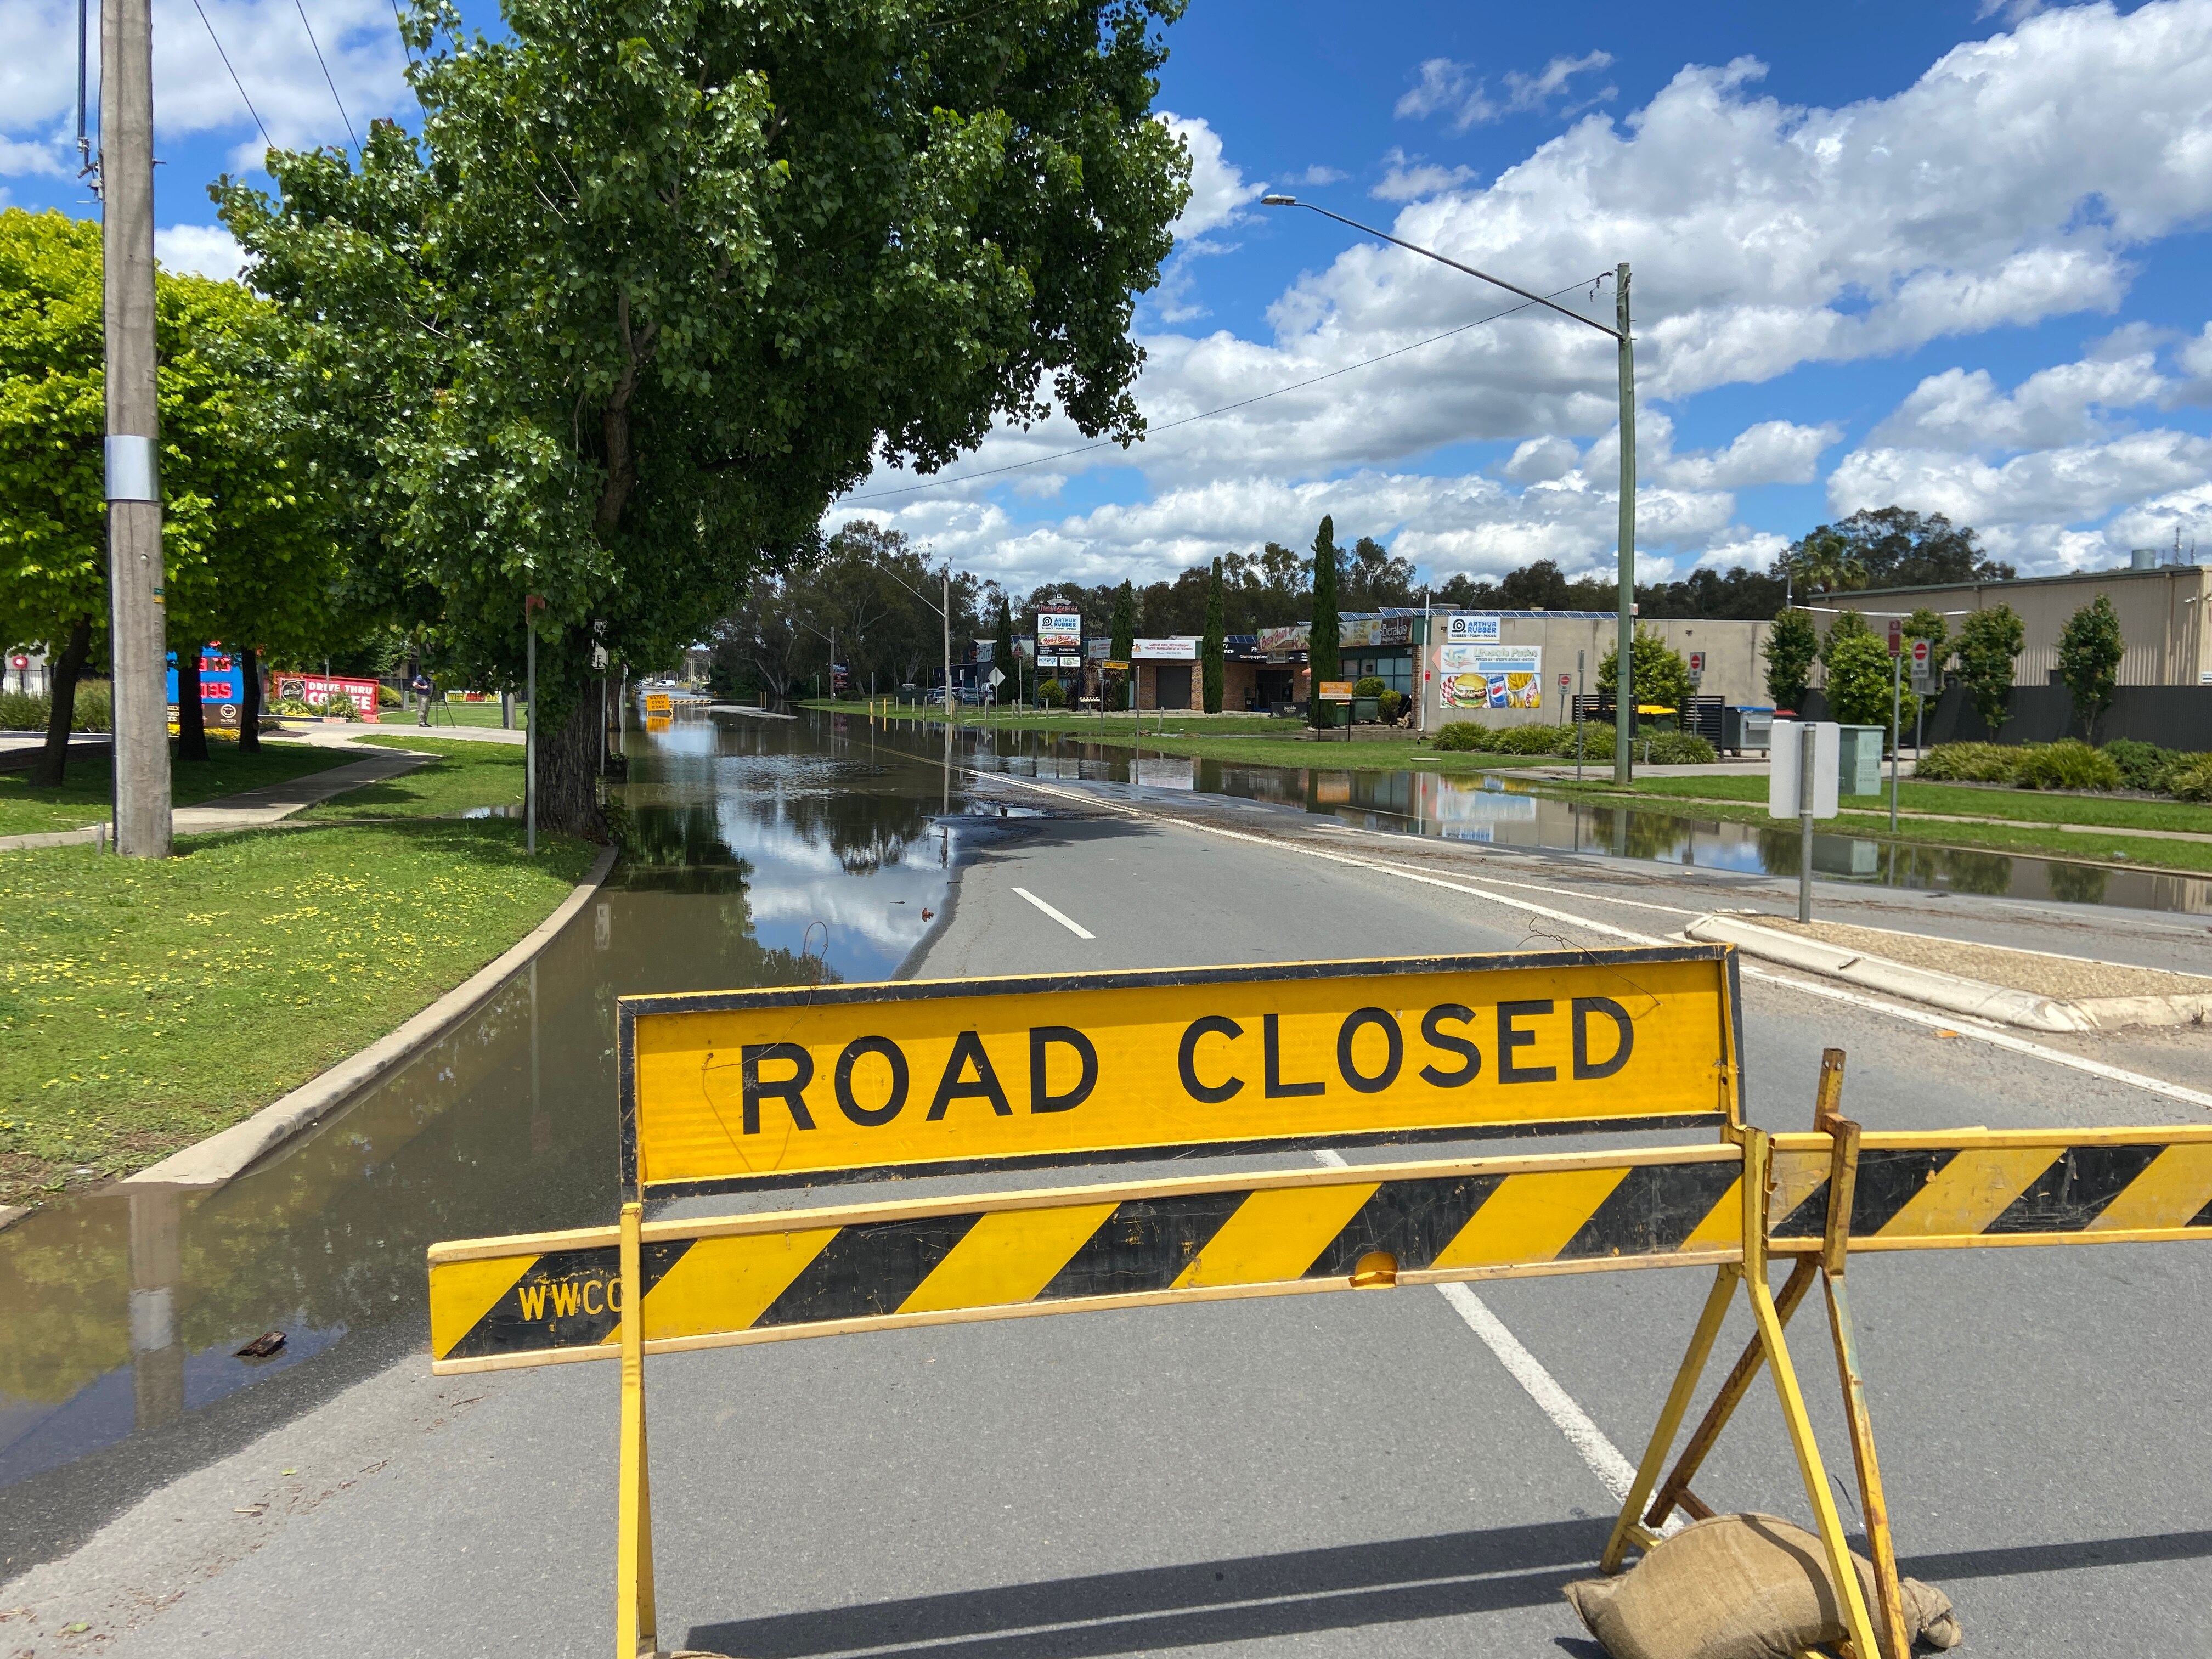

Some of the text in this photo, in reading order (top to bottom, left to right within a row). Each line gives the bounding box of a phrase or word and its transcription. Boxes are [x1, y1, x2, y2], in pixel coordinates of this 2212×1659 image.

[308, 682, 336, 692] DRIVE
[344, 685, 373, 695] THRU
[303, 692, 371, 710] COEE
[742, 997, 1634, 1135] ROAD CLOSED
